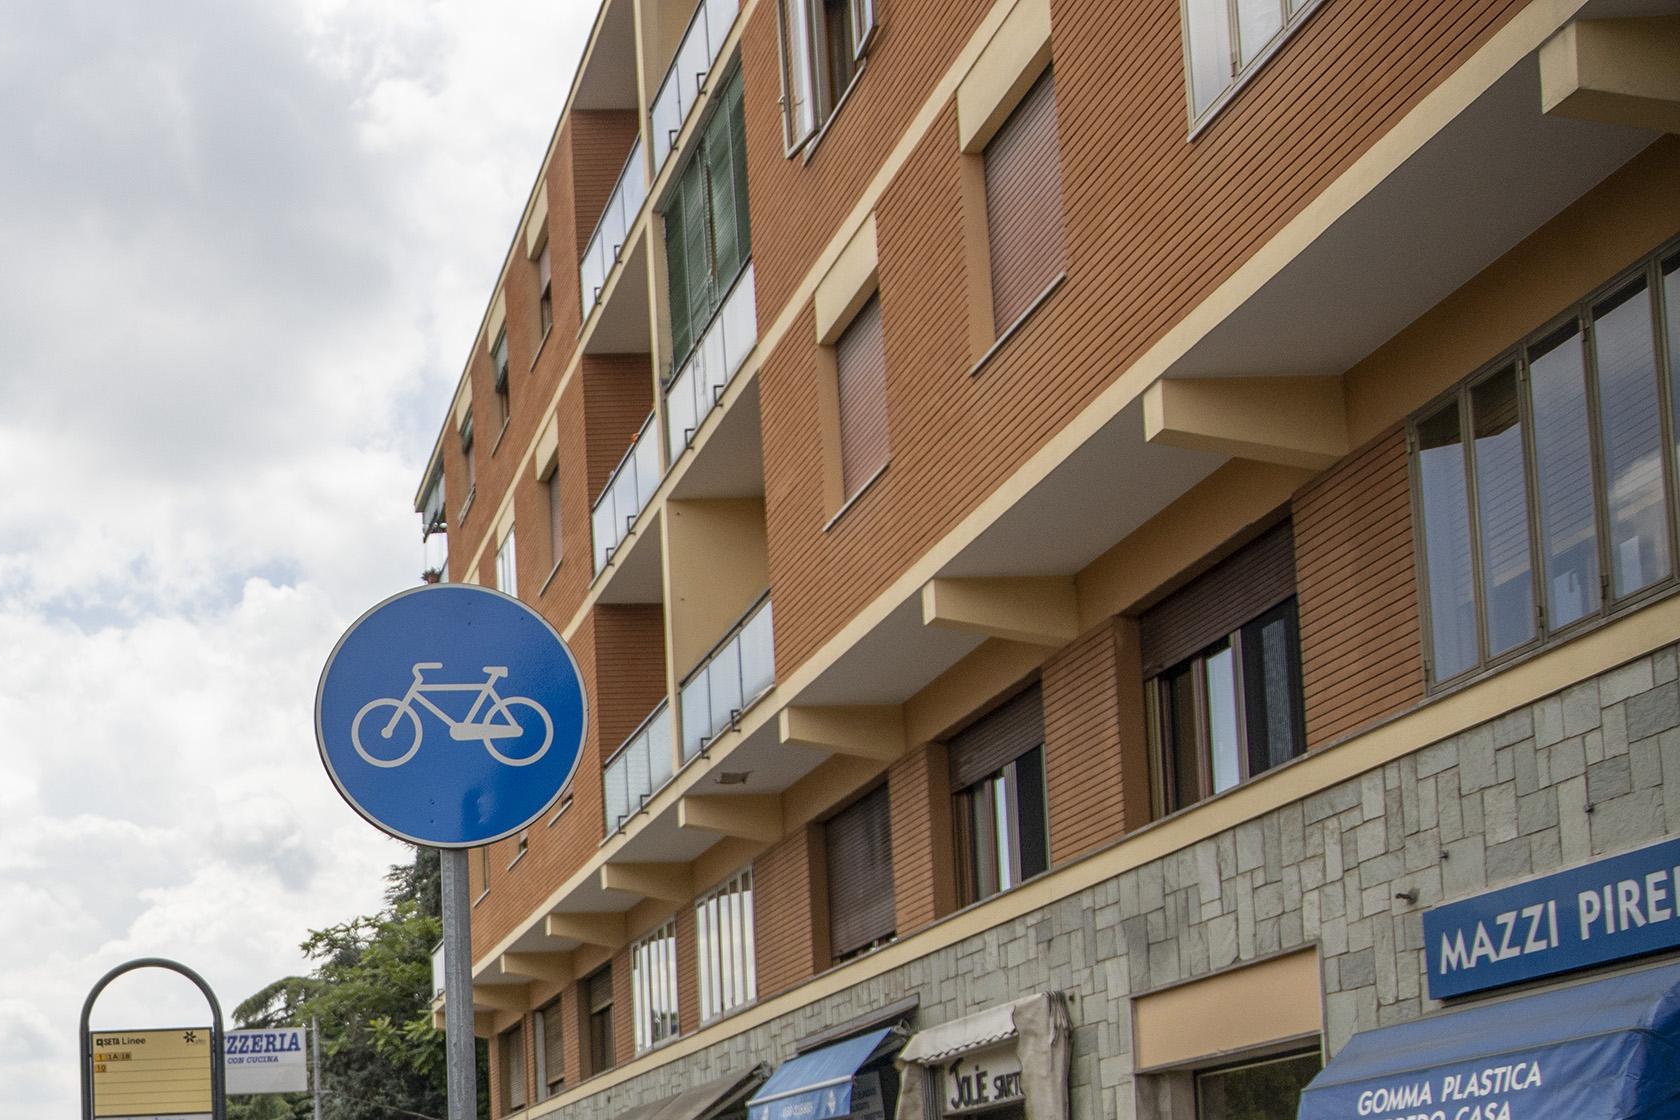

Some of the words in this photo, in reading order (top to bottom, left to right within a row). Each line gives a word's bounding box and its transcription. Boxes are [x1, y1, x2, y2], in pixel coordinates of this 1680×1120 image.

[1439, 899, 1559, 975] MAZZI
[103, 1037, 120, 1046] SETA
[121, 1037, 146, 1045] Linee
[224, 1032, 301, 1054] ZZERIA
[227, 1056, 245, 1064] CON
[246, 1055, 279, 1064] CUCINA
[993, 1070, 1024, 1100] SART
[1357, 1080, 1432, 1116] GOMMA
[1441, 1060, 1543, 1102] PLASTICA
